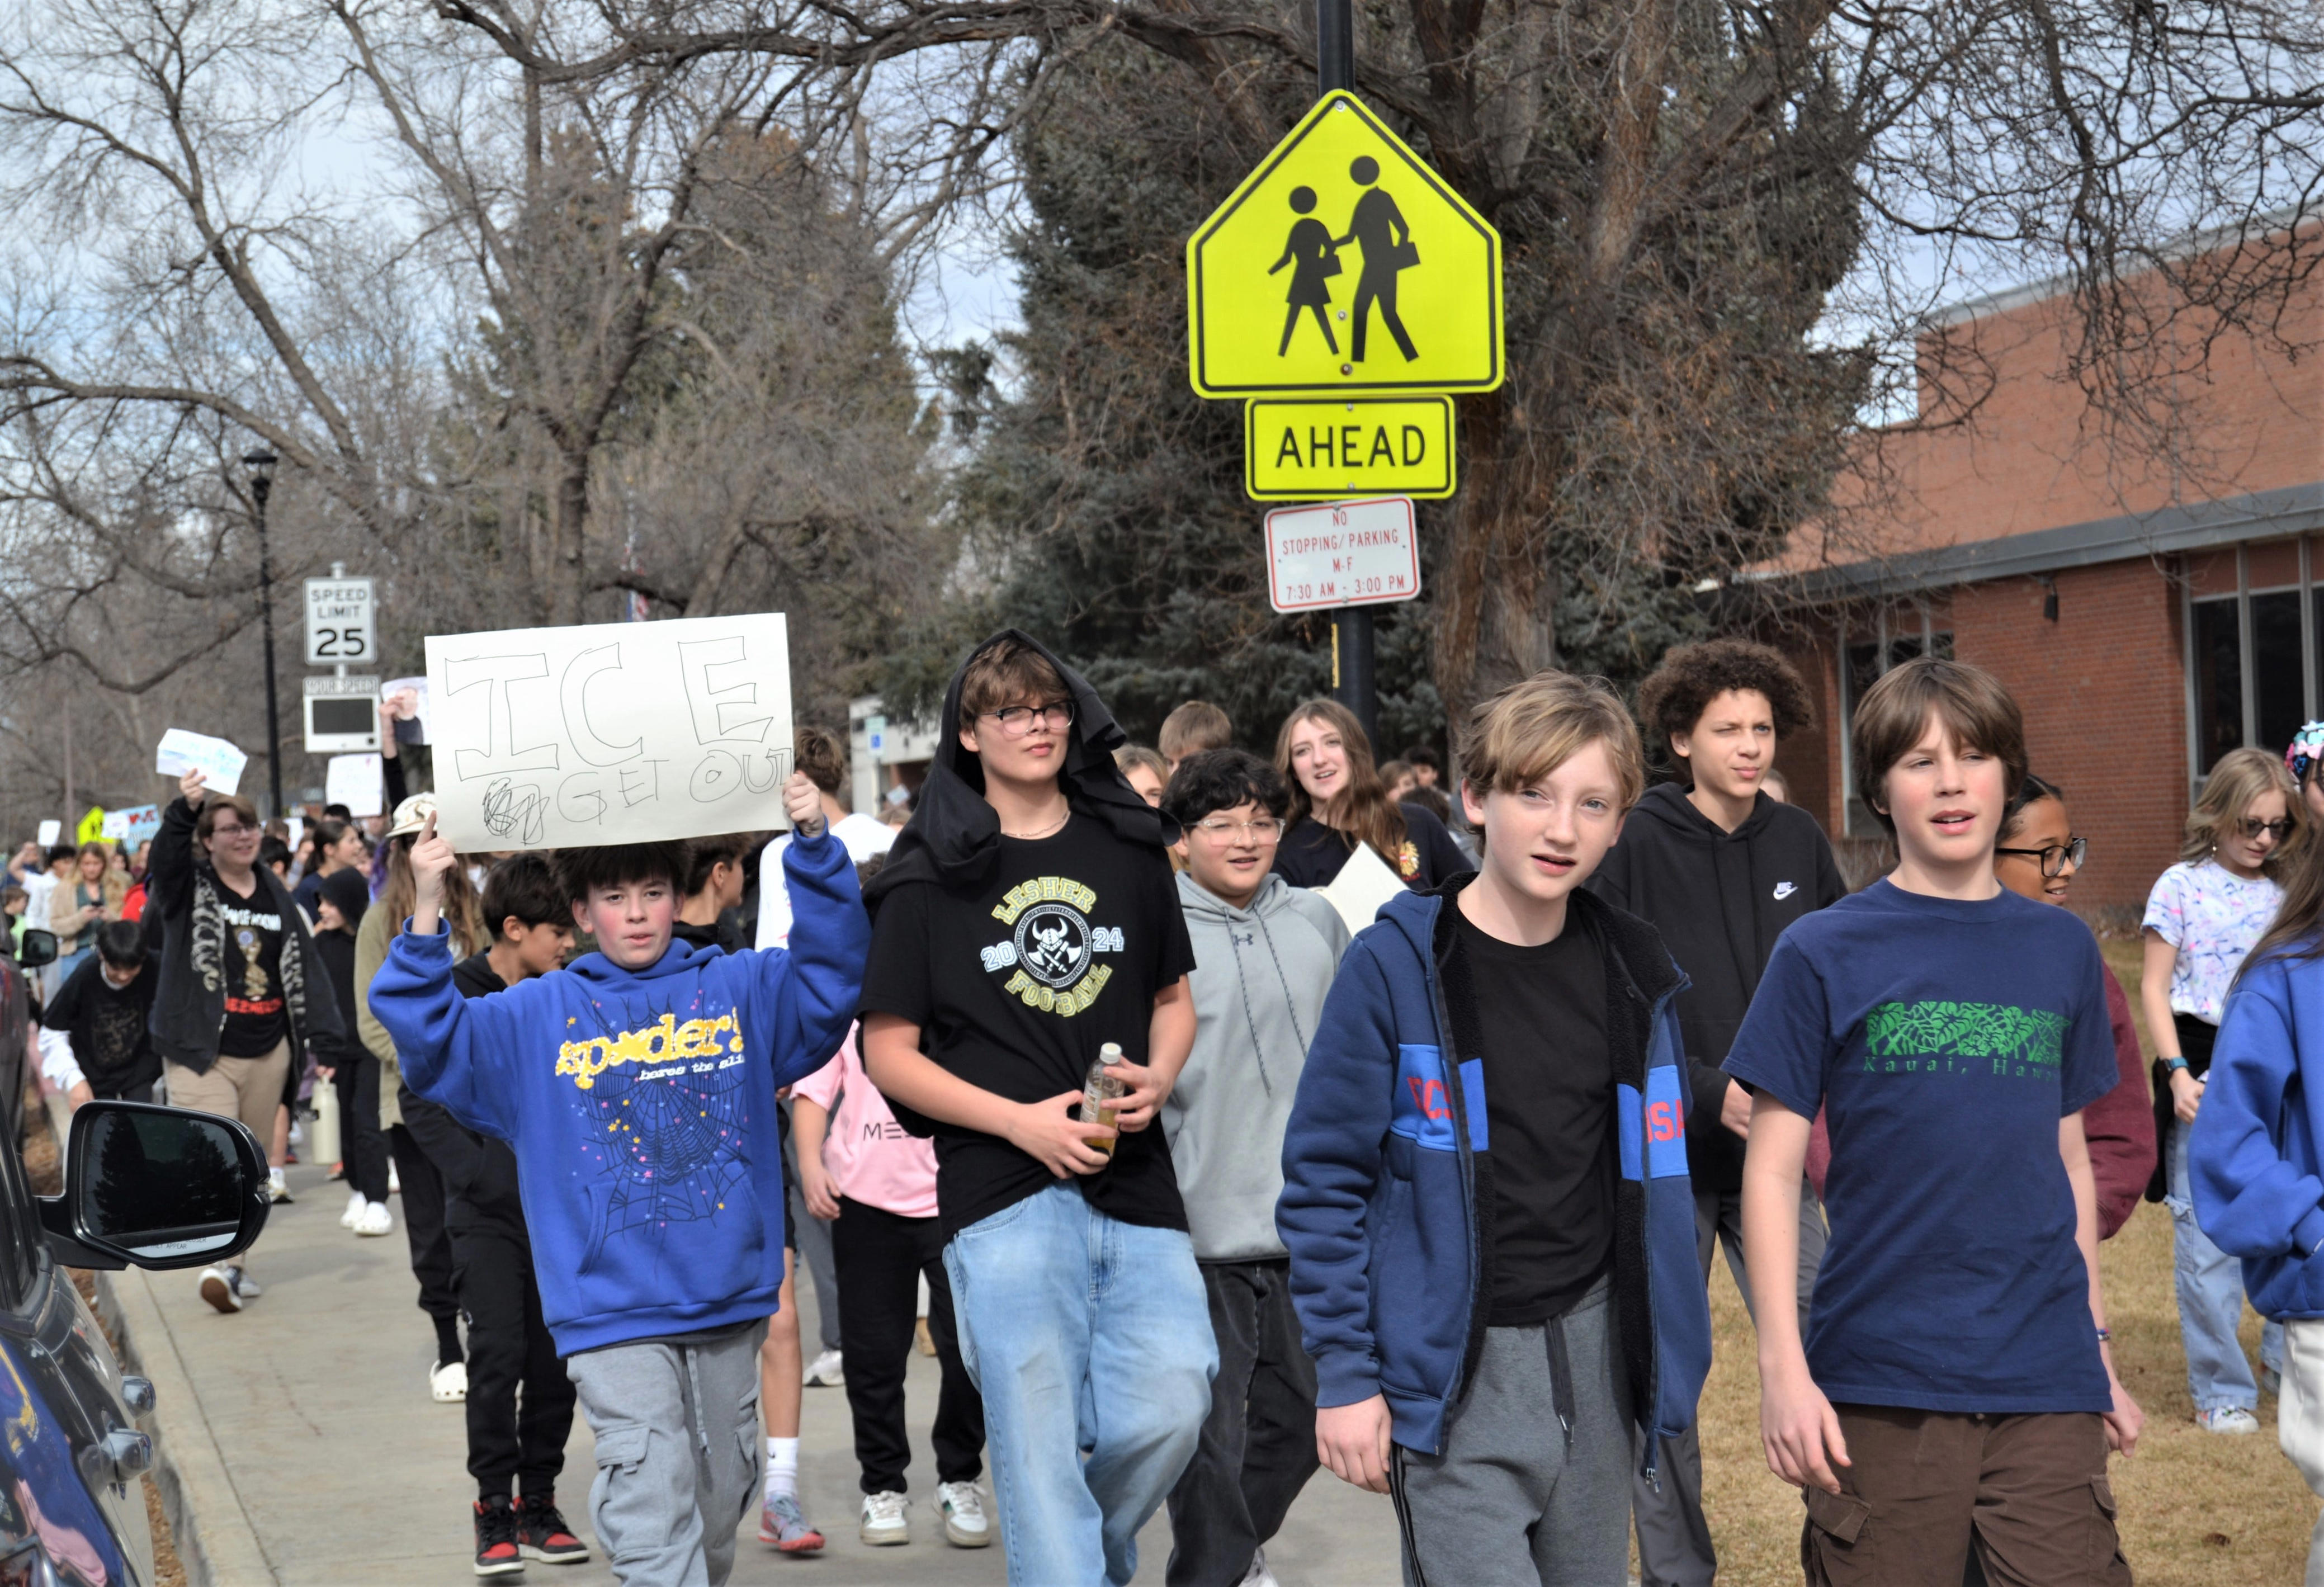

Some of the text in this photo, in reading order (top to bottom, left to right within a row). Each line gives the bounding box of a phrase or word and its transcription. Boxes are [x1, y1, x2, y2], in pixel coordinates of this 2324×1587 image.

[1276, 425, 1425, 467] AHEAD
[1333, 511, 1347, 526] NO
[1349, 528, 1399, 548] PARKING
[311, 588, 367, 602] SPEED
[1287, 584, 1311, 601] 7:30
[1320, 582, 1334, 598] AM
[1355, 577, 1381, 594] 3:00
[1388, 574, 1405, 590] PM
[317, 605, 360, 618] LIMIT
[317, 627, 365, 656] 25
[307, 679, 377, 695] YOUR SPEED
[445, 636, 773, 781] ICE
[557, 759, 669, 825] GET
[991, 876, 1097, 925] LESHER
[980, 927, 1125, 973] 20 24
[1004, 963, 1113, 1018] FOOBALL
[691, 1061, 714, 1073] the
[1863, 1056, 1967, 1075] Kauai,
